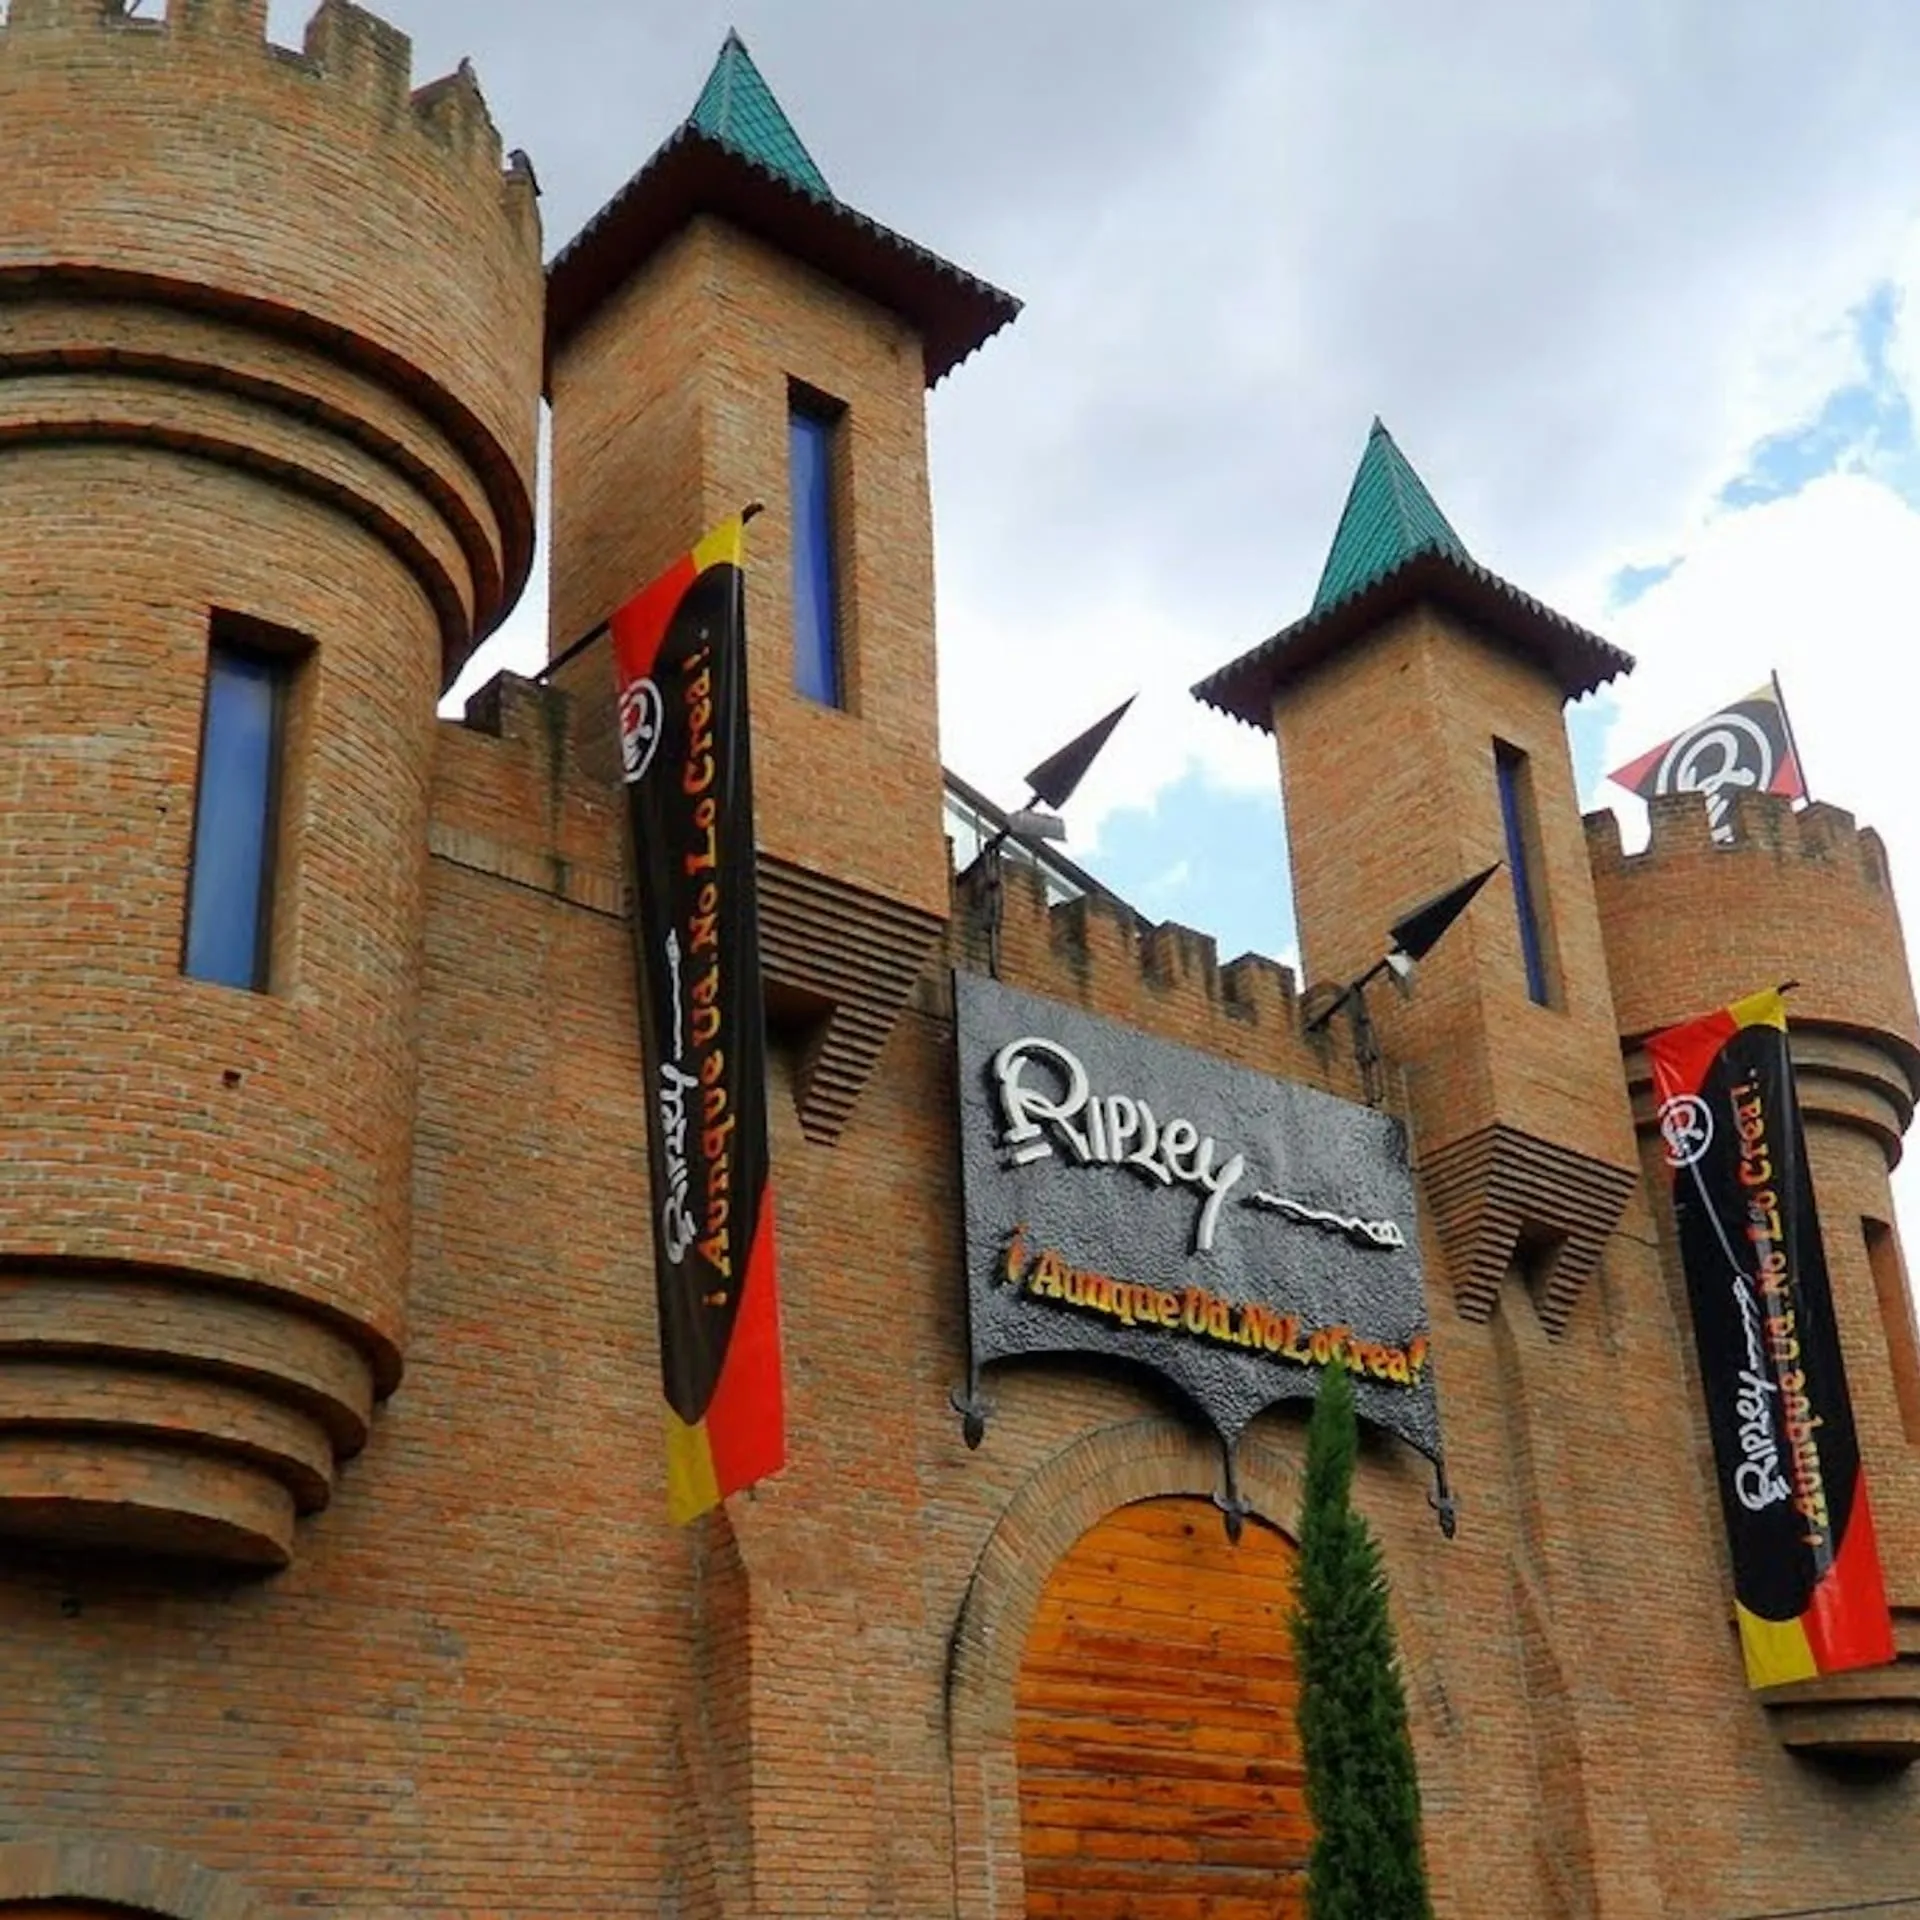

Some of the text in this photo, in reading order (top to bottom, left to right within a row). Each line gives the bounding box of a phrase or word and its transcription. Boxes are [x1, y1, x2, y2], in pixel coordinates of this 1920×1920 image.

[684, 797, 716, 876] Lo
[690, 882, 718, 952] No
[1747, 1190, 1783, 1241] Lo
[1757, 1250, 1789, 1294] No
